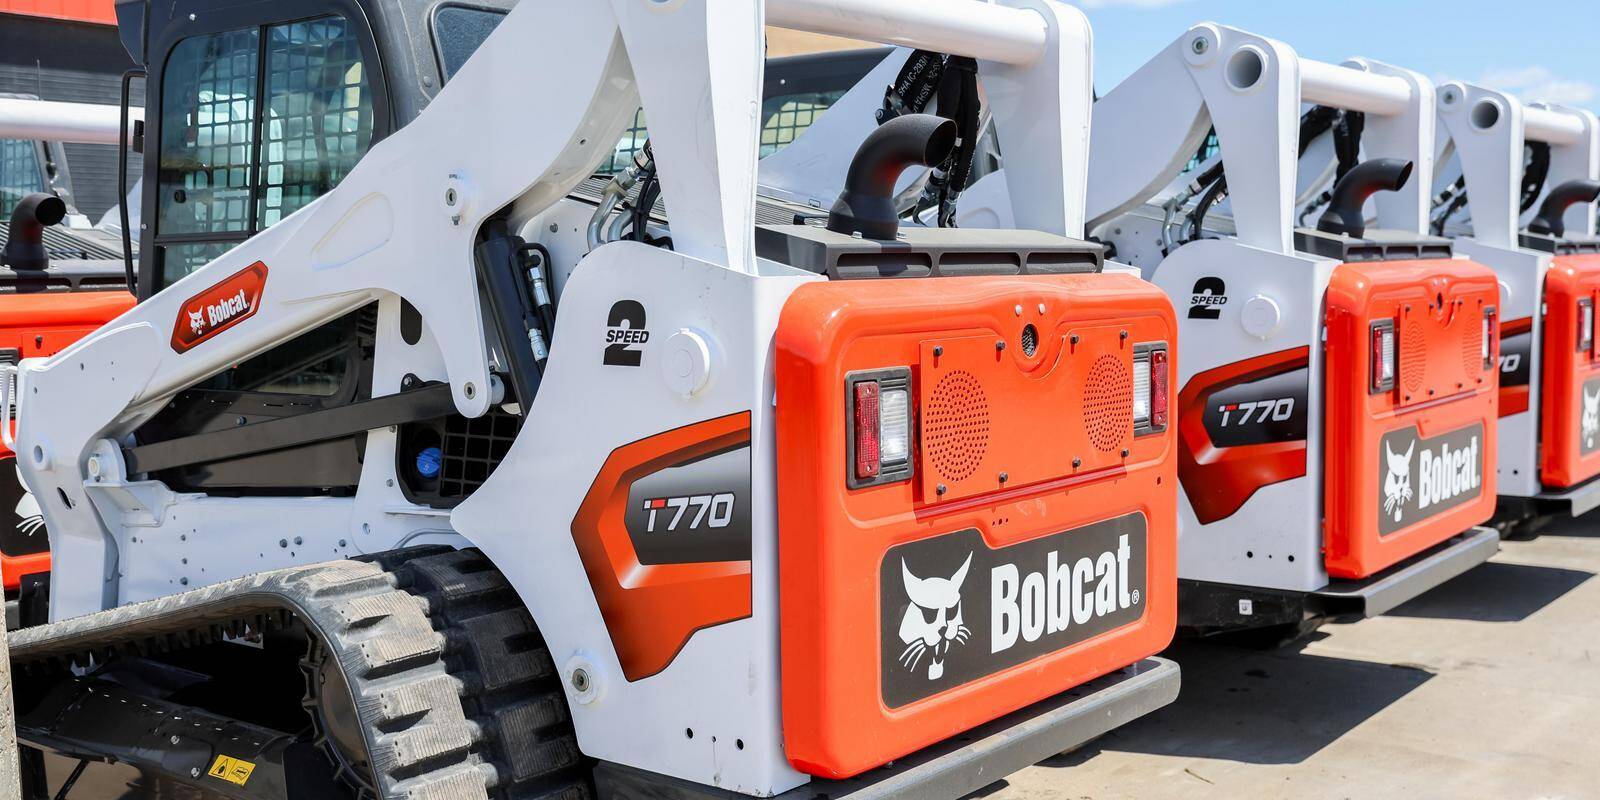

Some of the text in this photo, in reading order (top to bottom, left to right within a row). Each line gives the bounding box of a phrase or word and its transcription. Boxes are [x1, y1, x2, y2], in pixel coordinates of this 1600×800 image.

[1188, 276, 1226, 320] 2
[1191, 295, 1228, 305] SPEED
[603, 299, 647, 367] 2
[605, 329, 650, 344] SPEED
[1218, 397, 1295, 427] T770
[643, 492, 735, 532] T770
